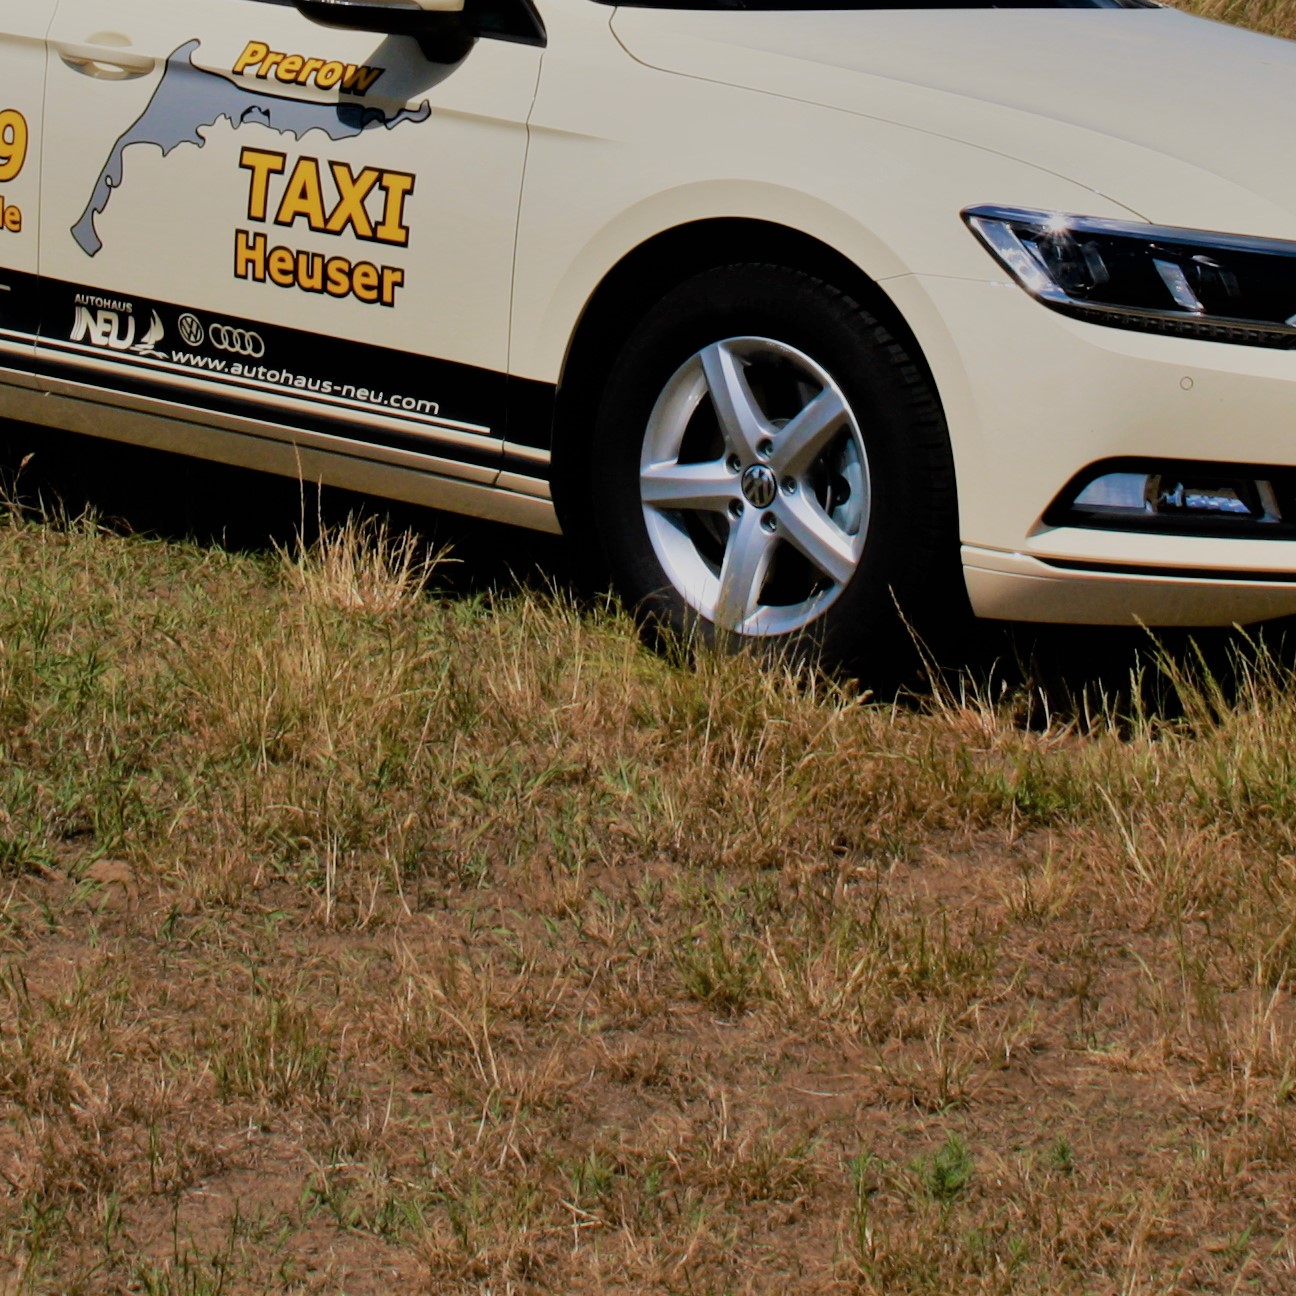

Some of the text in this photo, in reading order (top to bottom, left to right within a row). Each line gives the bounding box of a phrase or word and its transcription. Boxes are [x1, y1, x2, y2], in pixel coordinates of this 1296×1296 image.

[232, 40, 387, 97] Prerow
[239, 145, 417, 249] TAXI
[233, 227, 405, 309] Heuser
[69, 305, 136, 351] NEU
[74, 292, 134, 313] AUTOHAUS
[170, 349, 441, 416] www.autohaus-neu.com
